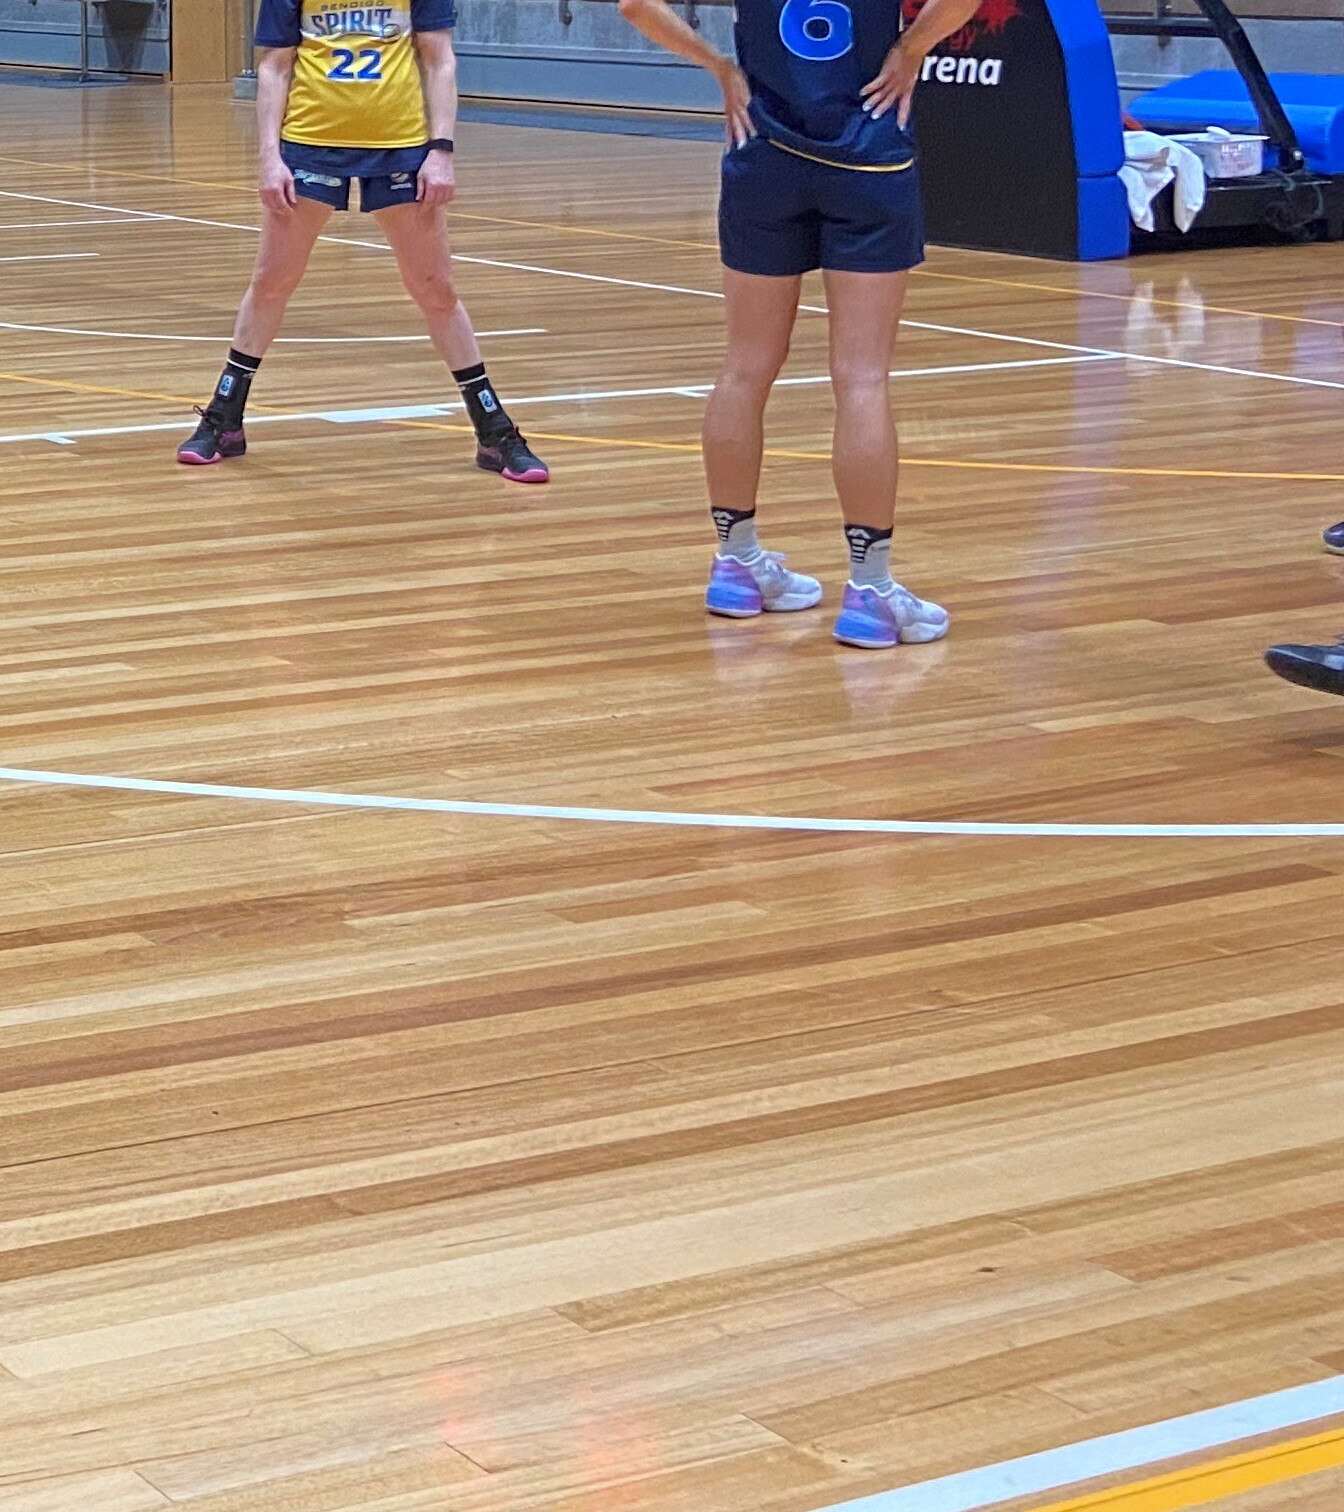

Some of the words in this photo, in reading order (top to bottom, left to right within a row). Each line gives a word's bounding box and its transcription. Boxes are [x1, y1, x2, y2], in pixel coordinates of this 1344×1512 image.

[310, 7, 393, 39] SPIRIT
[327, 48, 382, 81] 22
[921, 54, 1003, 86] rena
